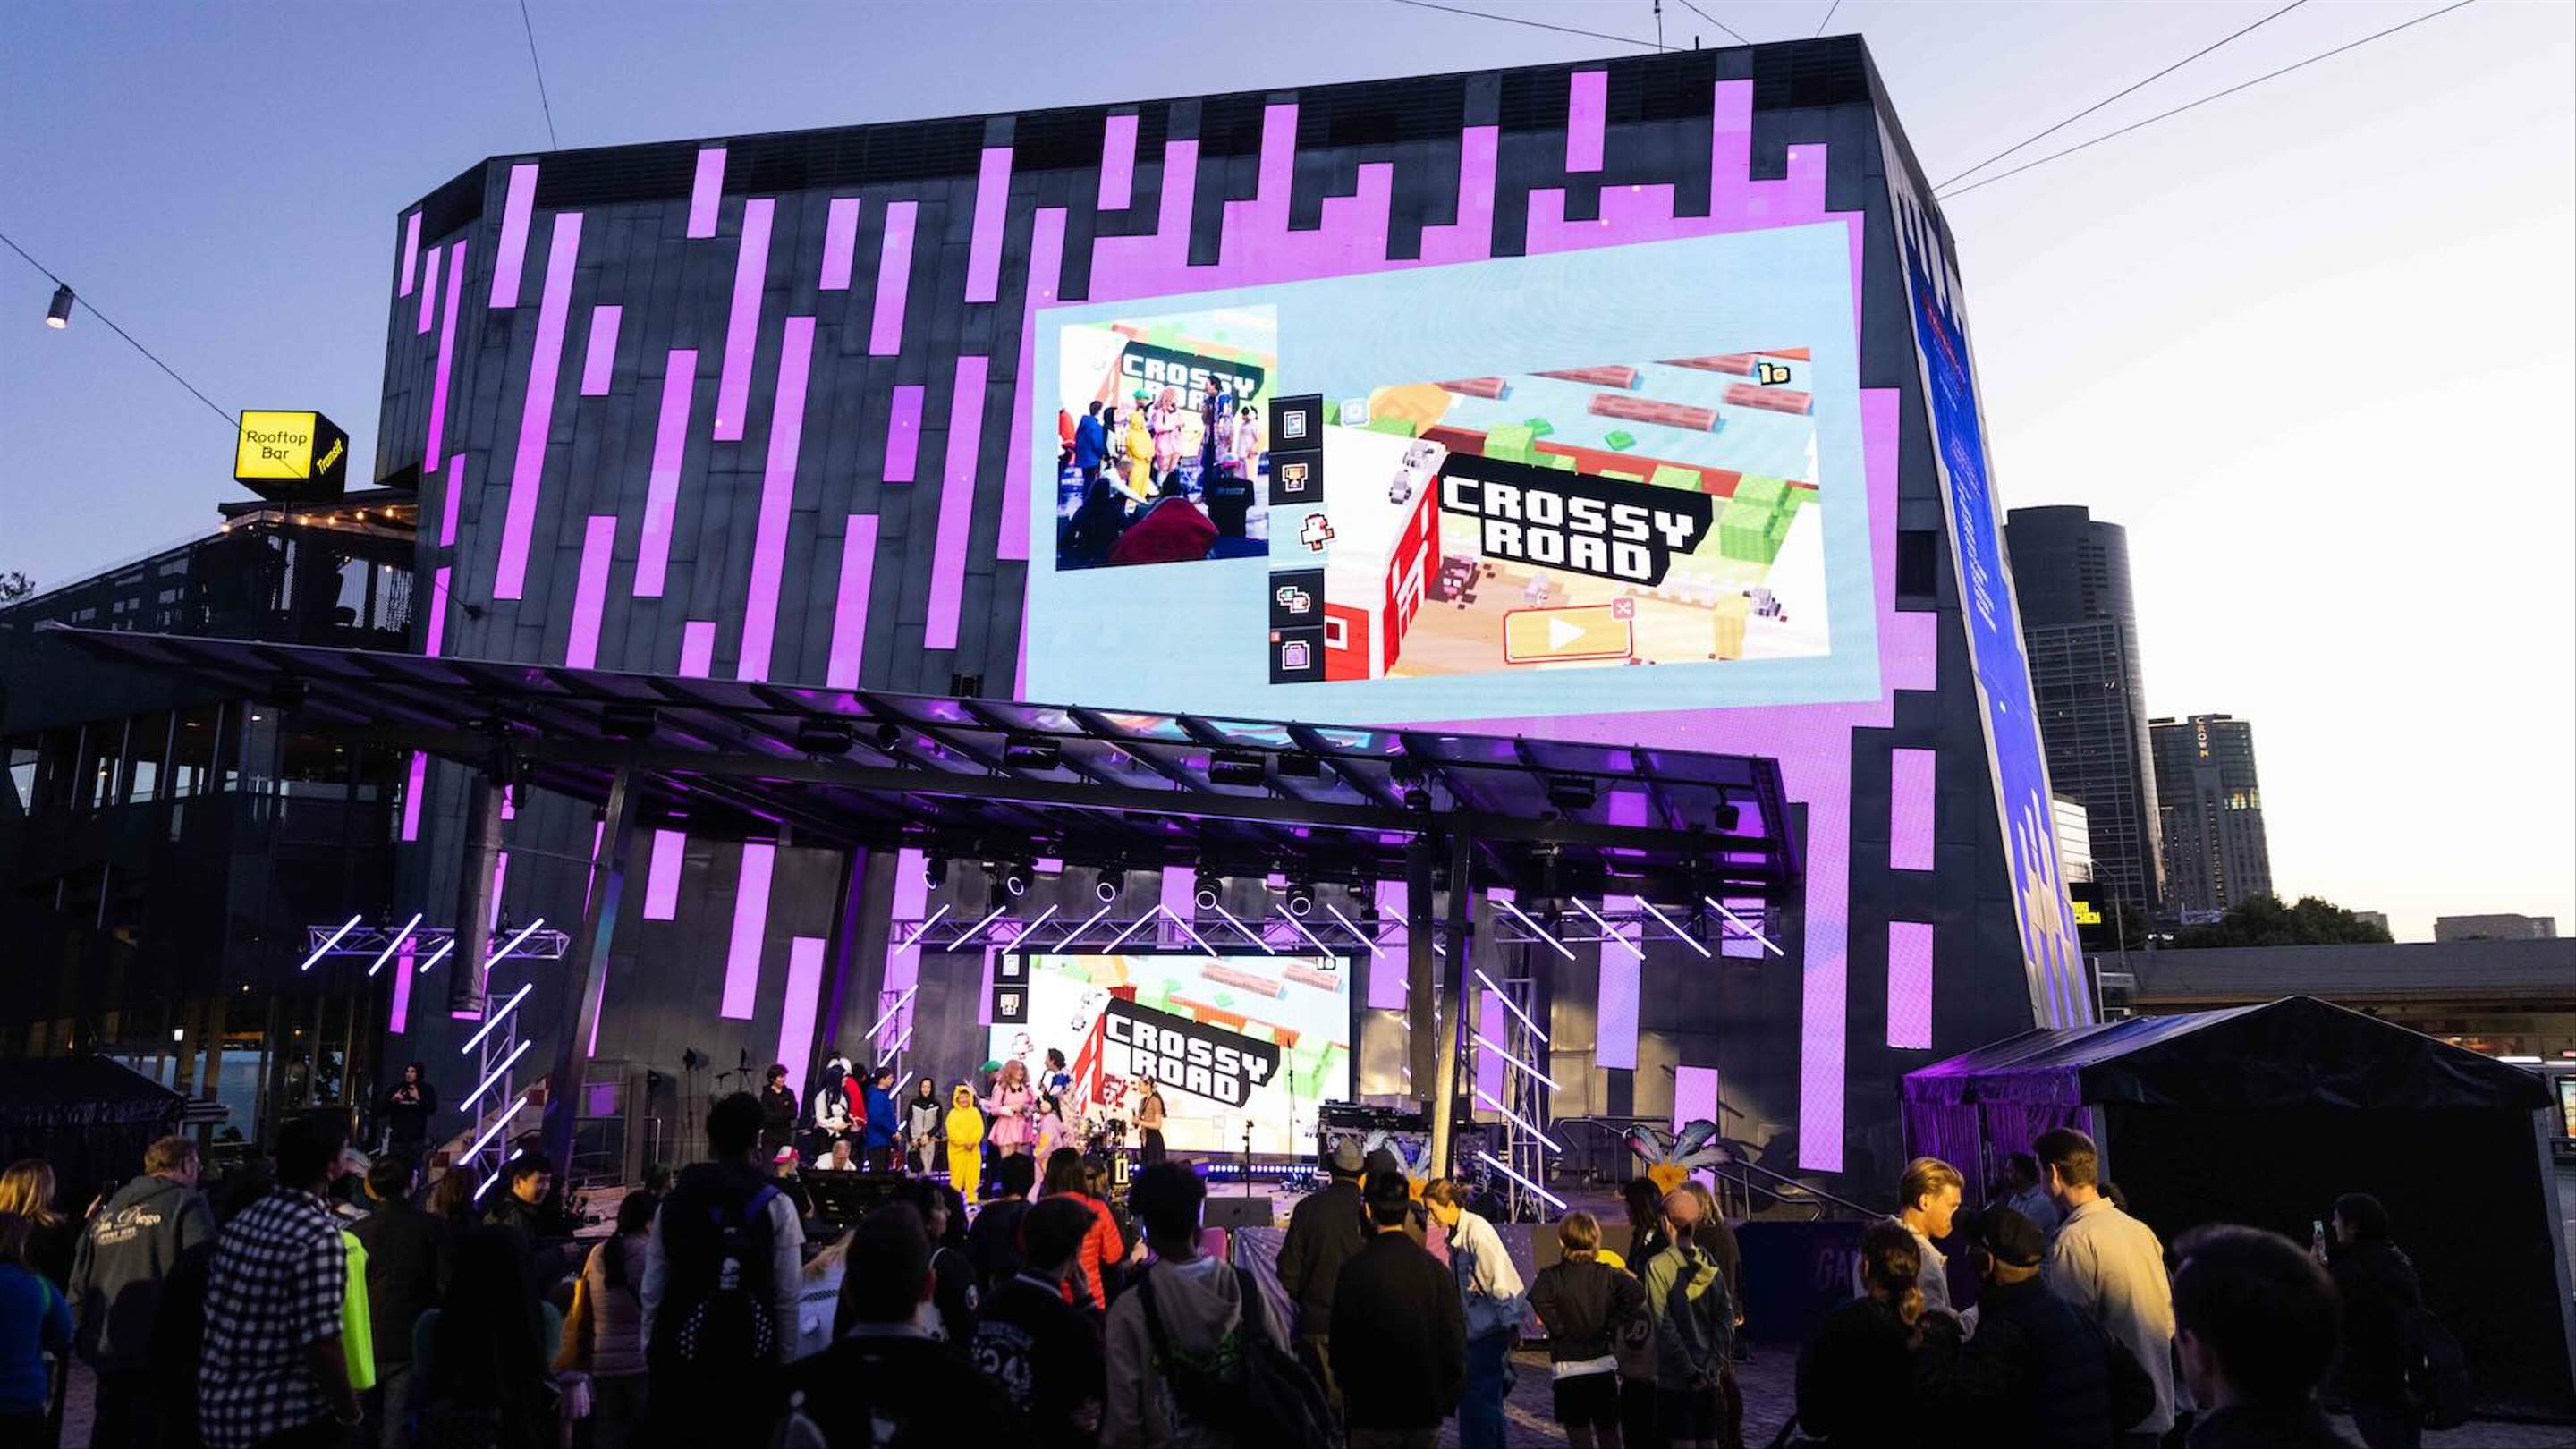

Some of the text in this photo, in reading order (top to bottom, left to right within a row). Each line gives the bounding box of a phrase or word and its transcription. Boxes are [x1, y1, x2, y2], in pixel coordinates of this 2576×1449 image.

[246, 430, 308, 446] Rooftop
[262, 447, 289, 460] Bar
[316, 437, 343, 475] Transit
[1443, 475, 1695, 547] CROSSY
[1484, 518, 1652, 580] ROAD
[2195, 716, 2209, 758] CROWN
[1106, 1013, 1268, 1083] CROSSY
[1131, 1047, 1241, 1104] ROAD
